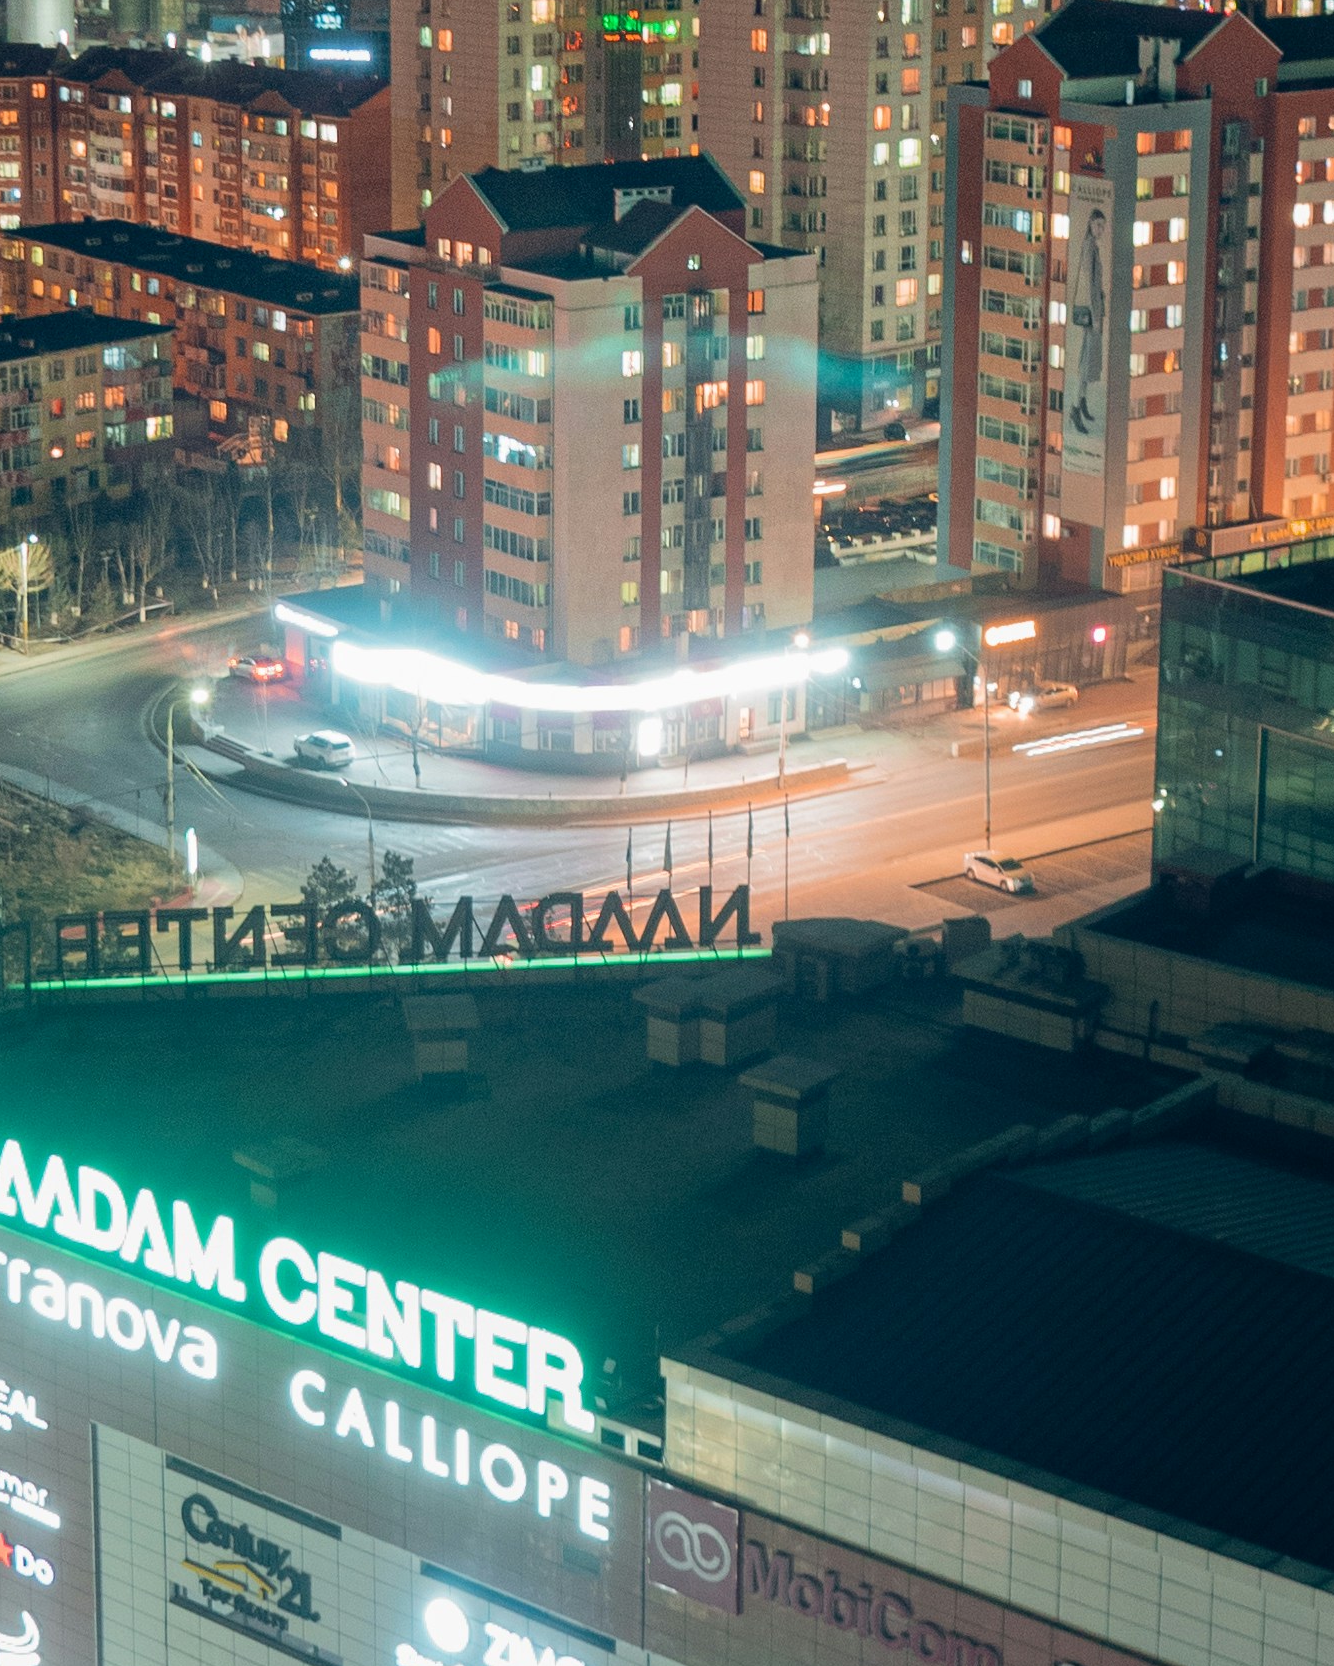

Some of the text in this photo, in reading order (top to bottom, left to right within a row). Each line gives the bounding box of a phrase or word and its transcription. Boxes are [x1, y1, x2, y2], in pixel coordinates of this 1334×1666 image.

[259, 1237, 596, 1433] CENTER
[181, 1493, 291, 1577] Century
[290, 1369, 611, 1542] CALLIOPE
